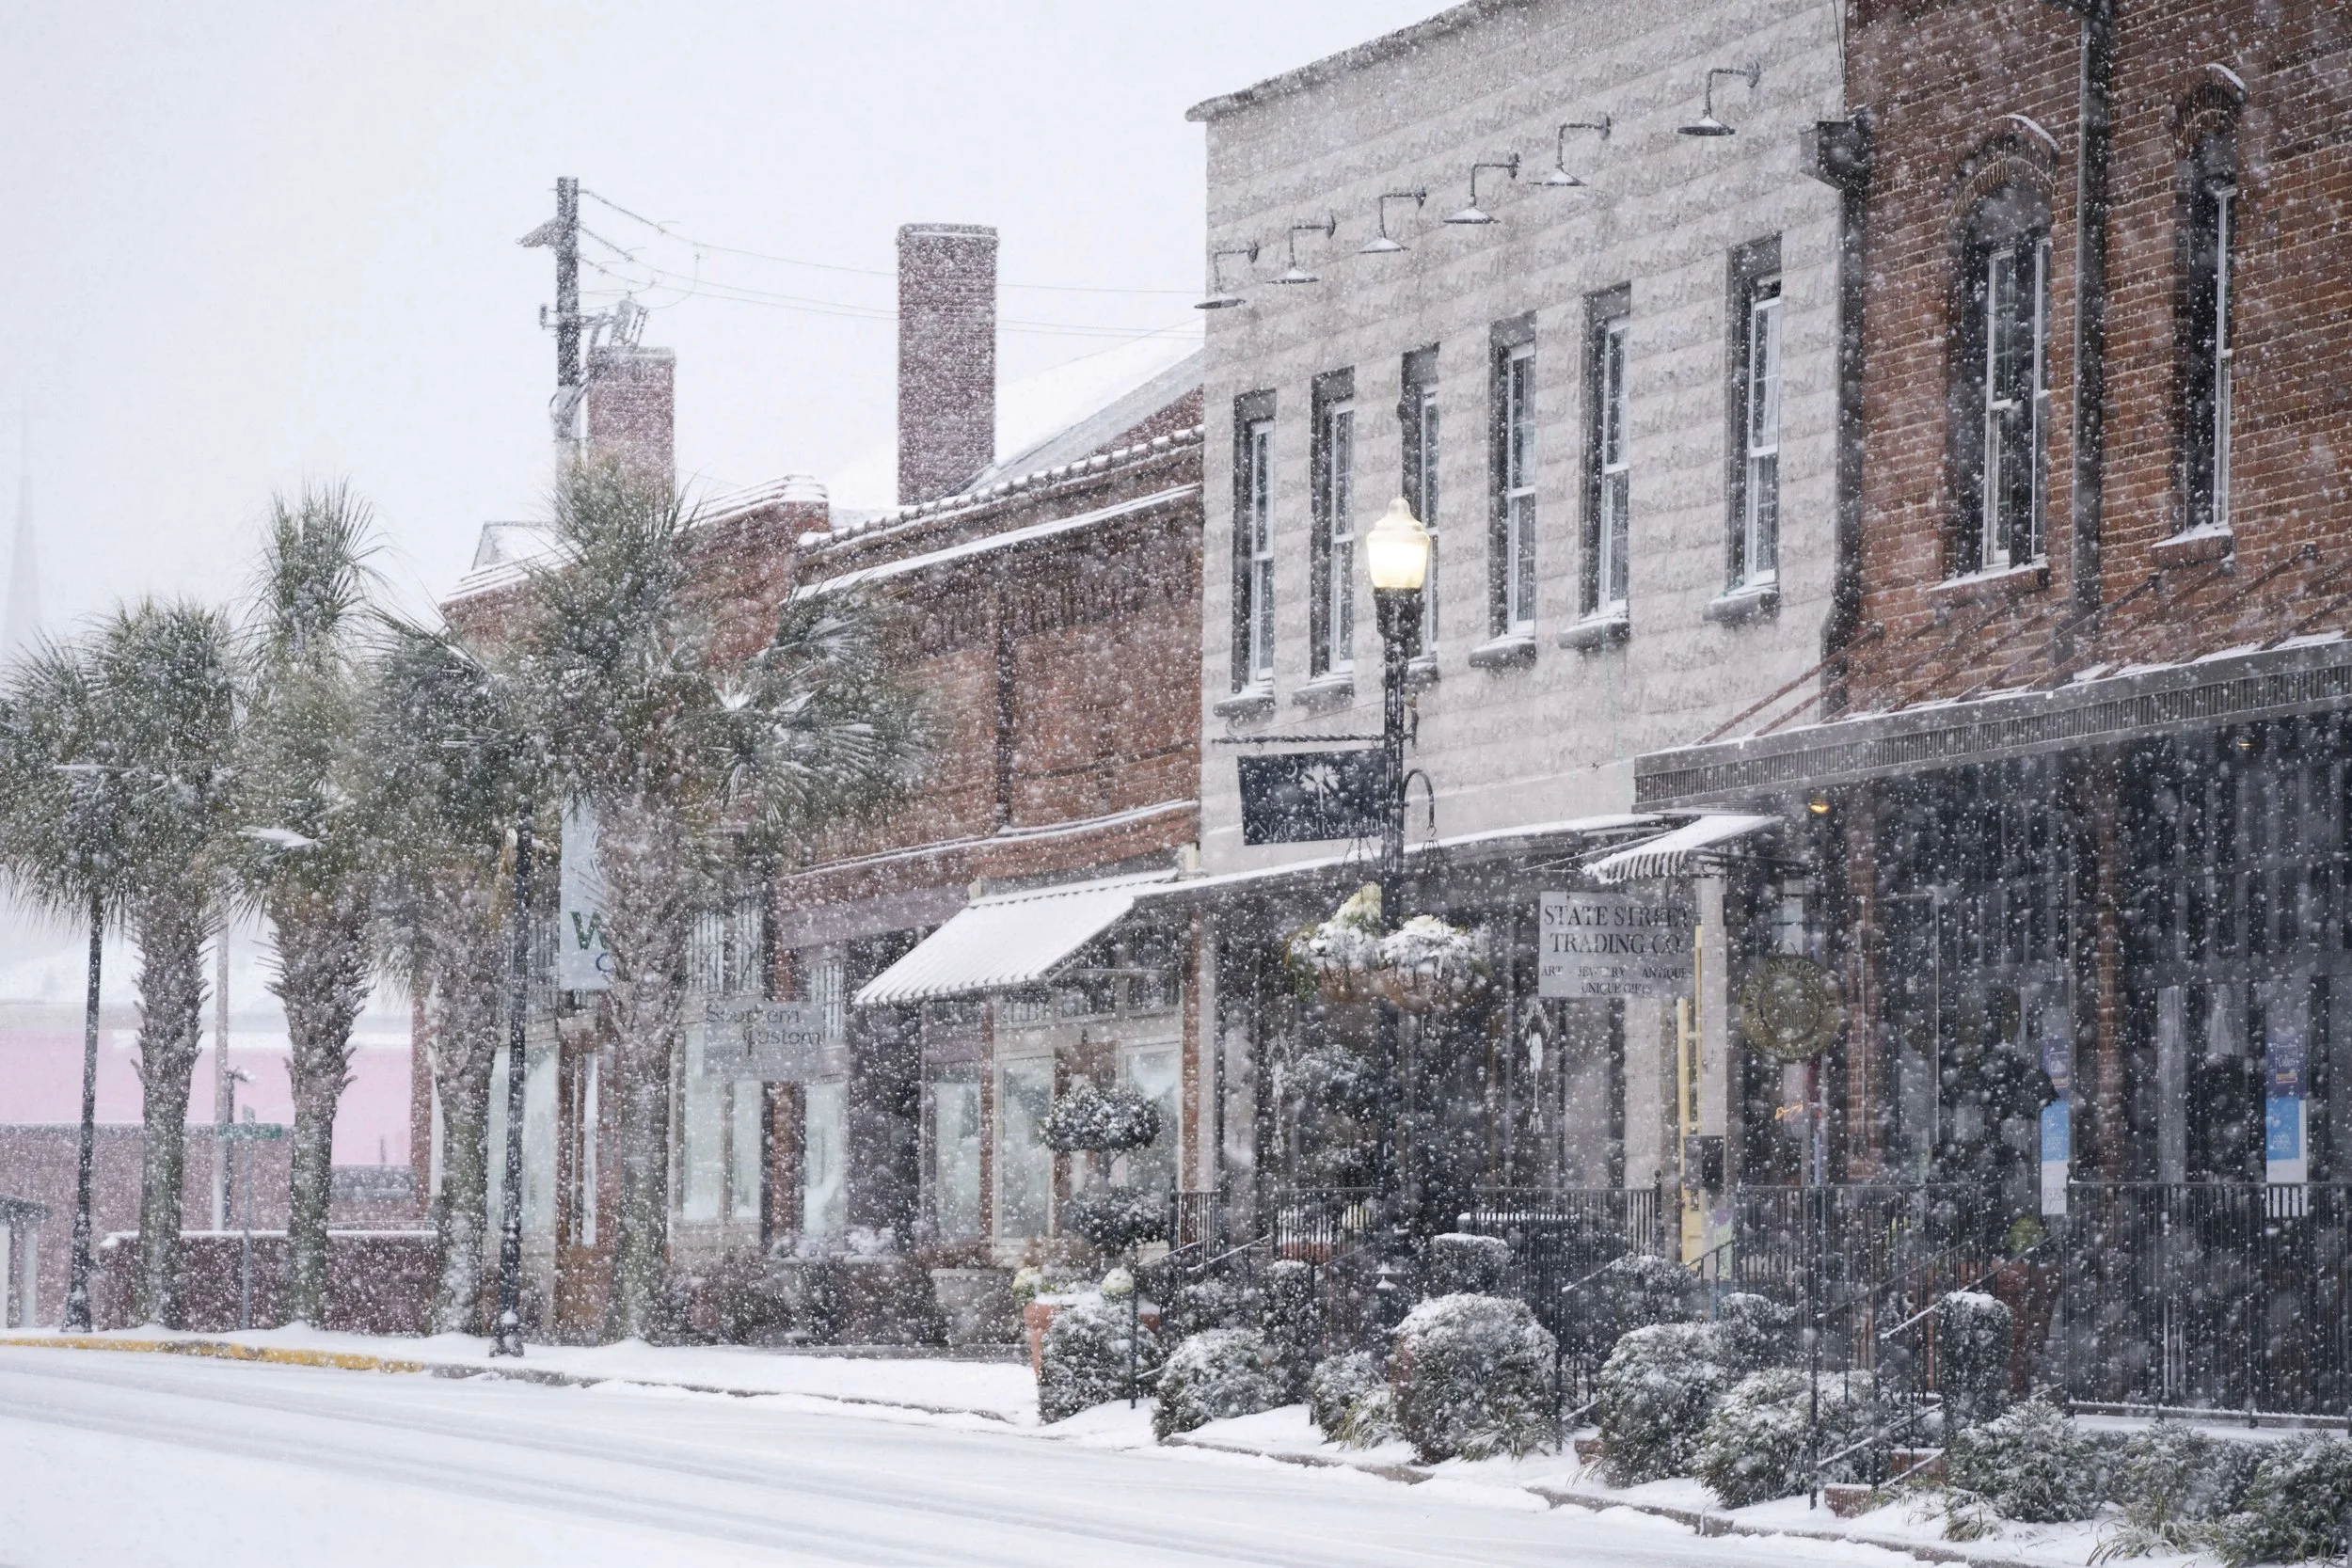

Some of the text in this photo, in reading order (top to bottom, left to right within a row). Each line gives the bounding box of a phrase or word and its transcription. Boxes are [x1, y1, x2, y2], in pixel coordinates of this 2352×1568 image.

[1544, 905, 1687, 927] STATE STREET
[1550, 932, 1685, 955] TRADING CO.
[1542, 965, 1692, 980] ART JEWRY ANTIQUES
[1581, 983, 1653, 995] UNIQUE GIFTS
[742, 1025, 820, 1045] Custom
